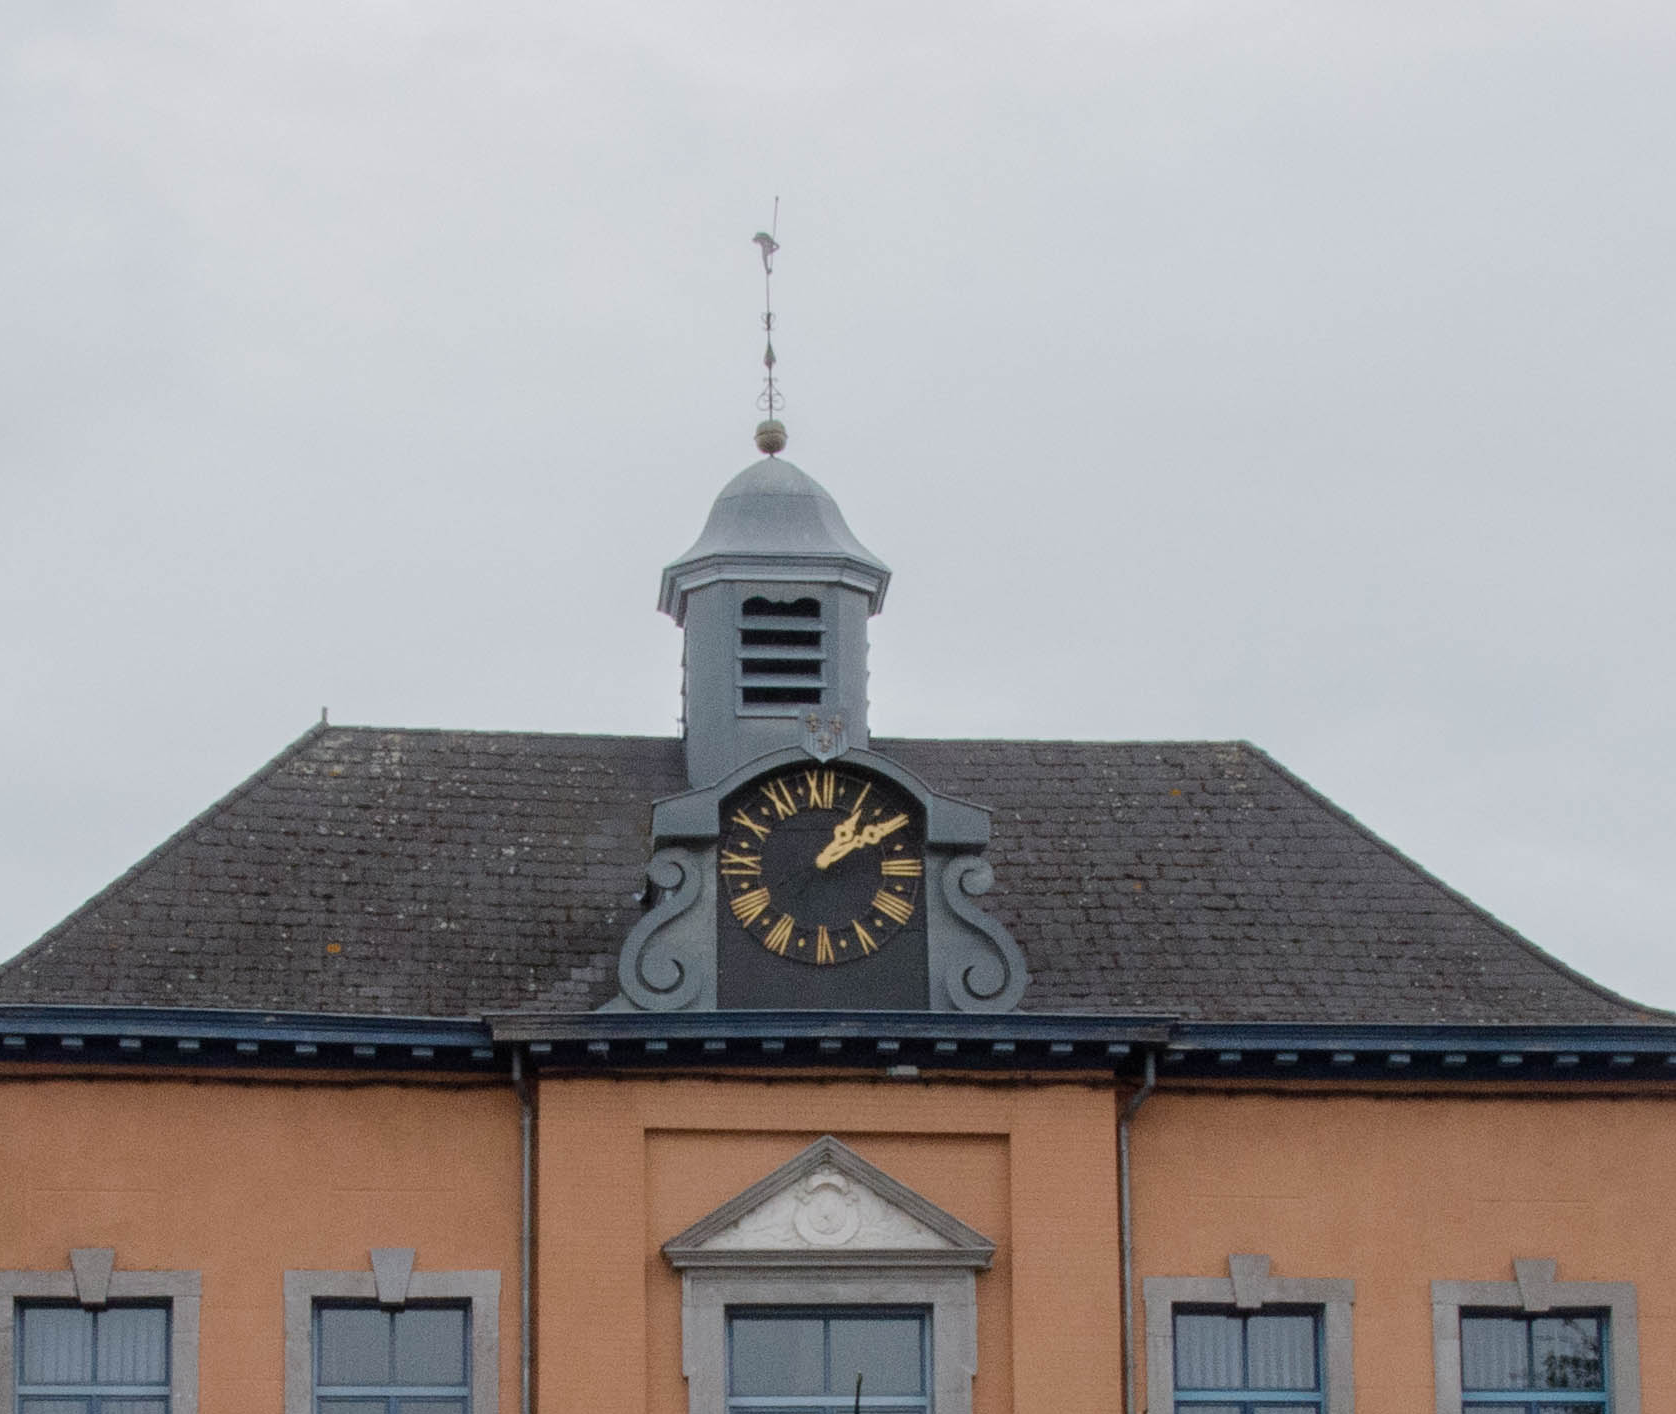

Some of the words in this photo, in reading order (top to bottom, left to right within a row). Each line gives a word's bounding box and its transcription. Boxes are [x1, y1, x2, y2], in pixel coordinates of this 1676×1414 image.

[760, 778, 798, 821] XI
[805, 770, 835, 809] XII
[731, 808, 771, 842] X
[720, 849, 762, 876] IX
[881, 858, 923, 877] III
[763, 913, 795, 956] VII
[816, 925, 836, 966] VI
[851, 918, 878, 956] V
